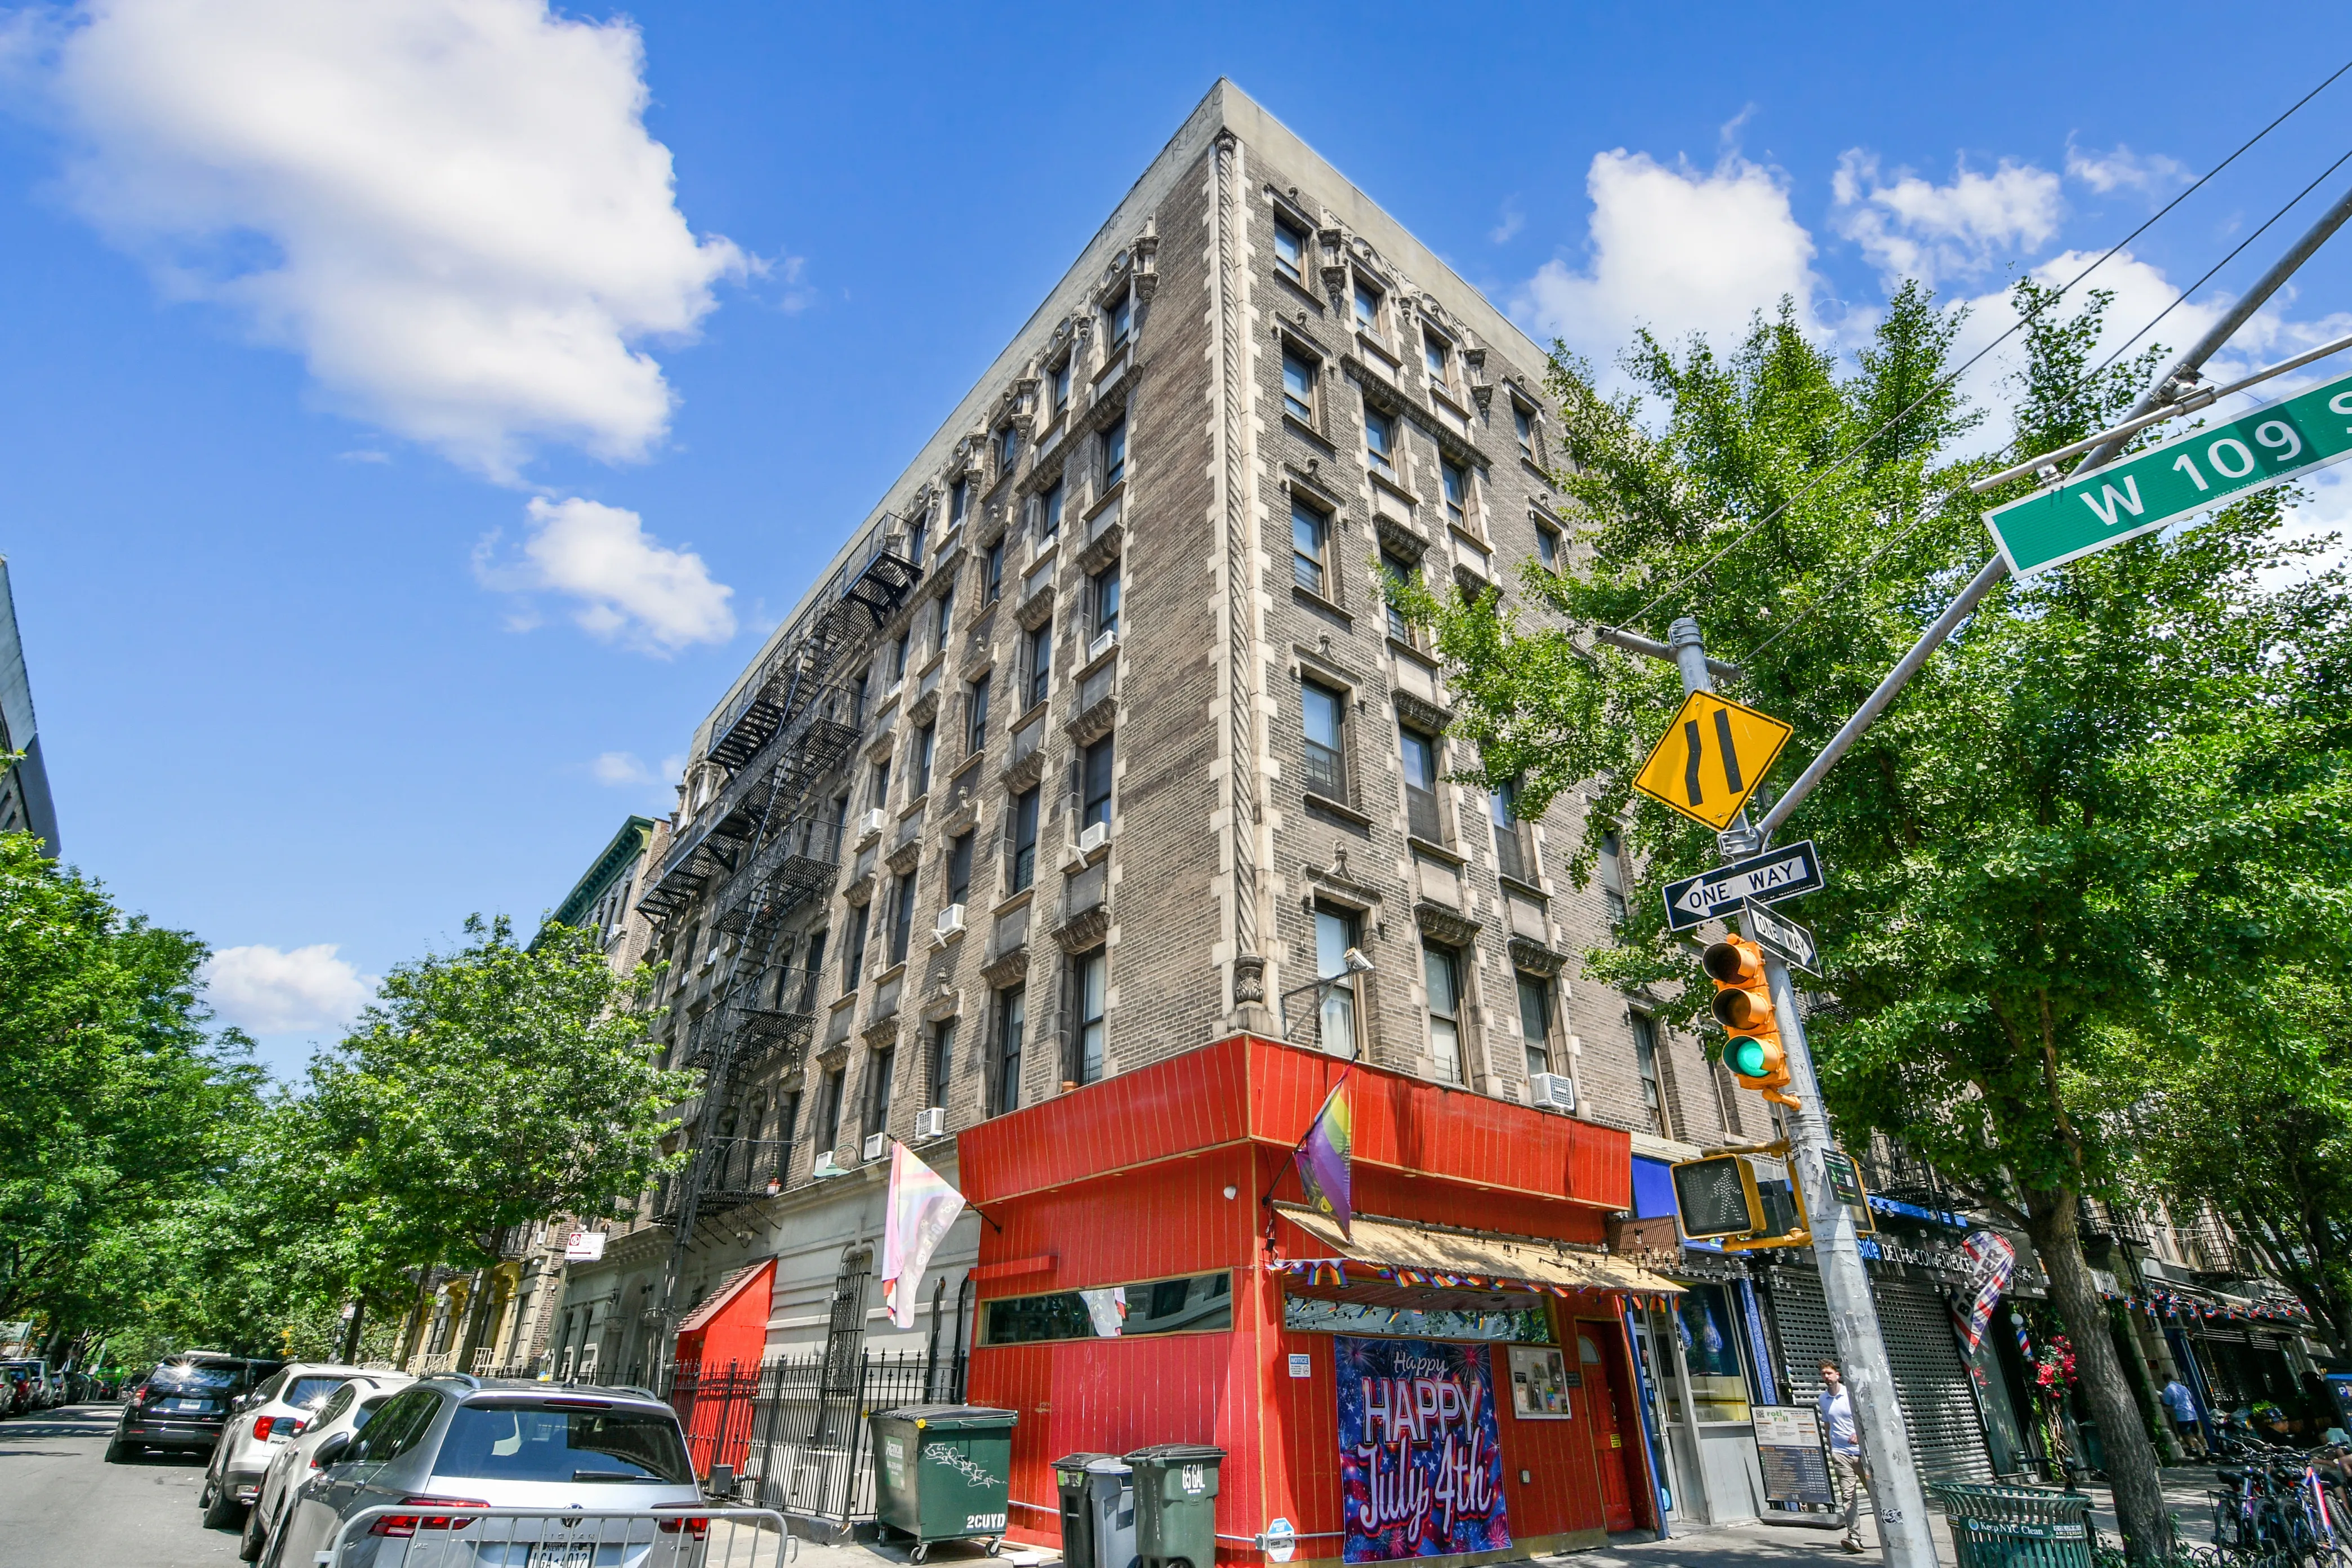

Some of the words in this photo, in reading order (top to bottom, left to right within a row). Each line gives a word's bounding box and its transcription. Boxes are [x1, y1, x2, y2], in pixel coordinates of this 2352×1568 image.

[2079, 474, 2144, 526] W
[2172, 420, 2302, 492] 109
[2213, 490, 2230, 500] DEPT
[2243, 464, 2302, 489] TRANSPORTATION
[1689, 883, 1730, 908] ONE
[1748, 861, 1793, 890] WAY
[1758, 916, 1780, 942] ONE
[1785, 931, 1806, 957] WAY
[1857, 1235, 1879, 1259] side
[1881, 1243, 1905, 1263] DELI
[1914, 1249, 1973, 1273] CONVENIENCE
[1393, 1351, 1449, 1381] Happy
[1362, 1378, 1481, 1445] HAPPY
[1182, 1464, 1191, 1489] 65
[1192, 1464, 1205, 1489] GAL
[1358, 1435, 1429, 1543] July
[1435, 1427, 1492, 1534] 4th
[966, 1513, 1006, 1529] 2CUYD
[1980, 1522, 1999, 1533] Keep
[2000, 1524, 2019, 1534] NYC
[2021, 1525, 2044, 1535] Clean
